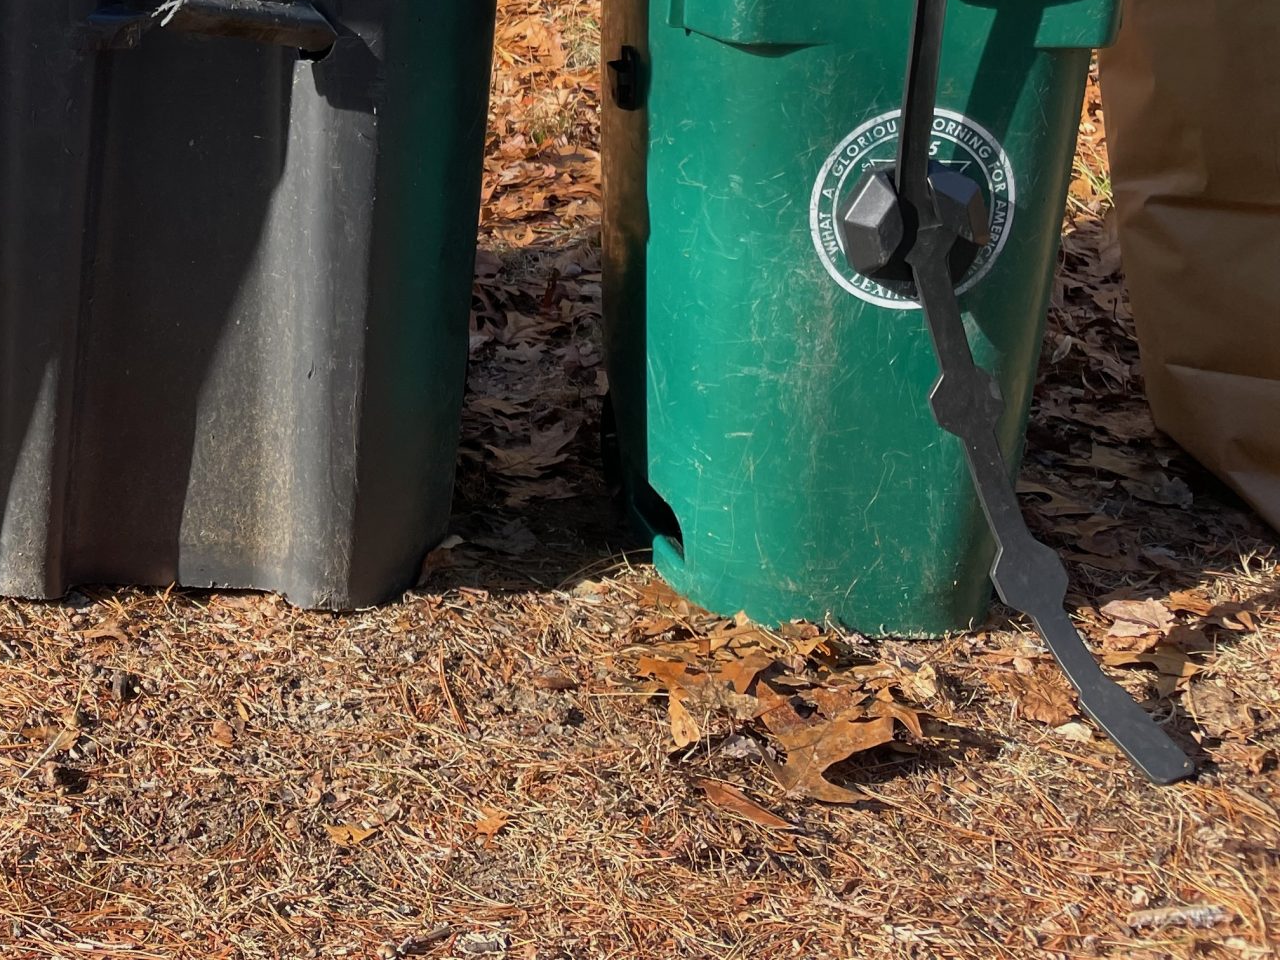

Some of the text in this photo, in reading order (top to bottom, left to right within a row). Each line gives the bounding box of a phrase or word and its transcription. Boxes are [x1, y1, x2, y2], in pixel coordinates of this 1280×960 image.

[822, 187, 836, 200] A
[831, 120, 898, 178] GLORIOU
[933, 118, 992, 159] ORNING
[987, 161, 1005, 192] FOR
